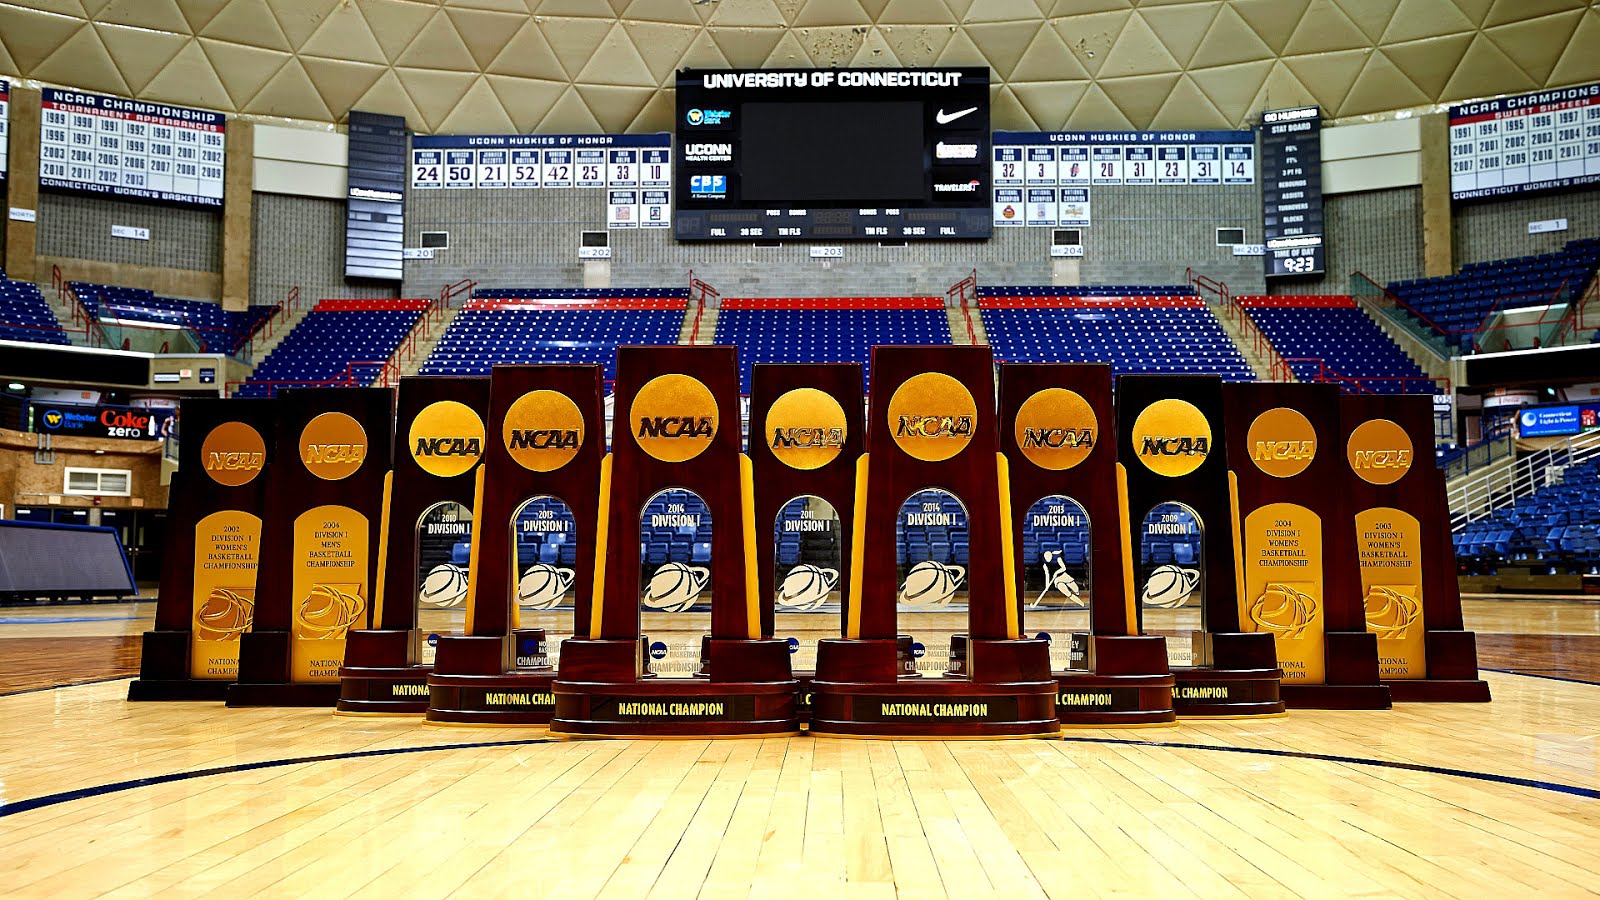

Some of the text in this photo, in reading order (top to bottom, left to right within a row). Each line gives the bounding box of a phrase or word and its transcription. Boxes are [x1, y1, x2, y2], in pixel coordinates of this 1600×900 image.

[704, 72, 962, 88] UNIVERSITY OF CONNECTICUT
[54, 91, 215, 122] NCAA CHAMPIONSHIP
[1460, 101, 1500, 116] NCAA
[1495, 99, 1590, 120] SWEET SIXTEEN
[52, 102, 217, 131] TOURNAMENT APPEARANCES
[46, 111, 221, 146] 1989 1990 1991 1992 1993 1994 1995
[1272, 122, 1311, 133] STAT BOARD
[1455, 111, 1578, 139] 1991 1994 1995 1996 1997
[45, 129, 221, 162] 1996 1997 1998 1999 2000 2001 2002
[510, 137, 554, 145] HUSKIES
[560, 137, 573, 145] OF
[1453, 128, 1580, 156] 2000 2001 2002 2003 2004
[686, 144, 732, 155] UCONN
[44, 146, 221, 178] 2003 2004 2005 2006 2007 2008 2009
[1454, 145, 1580, 172] 2007 2008 2009 2010 2011
[44, 164, 144, 186] 2010 2011 2012 2013
[417, 167, 438, 180] 24
[450, 167, 470, 180] 50
[485, 167, 501, 180] 21
[516, 167, 534, 180] 52
[548, 166, 568, 180] 42
[583, 166, 598, 180] 25
[617, 166, 629, 179] 33
[651, 166, 660, 179] 10
[1003, 163, 1014, 177] 32
[1039, 163, 1044, 177] 3
[1101, 163, 1113, 177] 20
[1134, 163, 1145, 177] 31
[1166, 163, 1178, 176] 23
[1198, 162, 1211, 176] 31
[1231, 162, 1245, 176] 14
[41, 178, 221, 206] CONNECTICUT WOMEN'S BASKETBALL
[1453, 179, 1569, 200] CONNECTICUT WOMEN'S
[134, 230, 146, 238] 14
[940, 227, 955, 235] FULL
[592, 249, 610, 257] 202
[1063, 247, 1082, 255] 204
[1274, 248, 1315, 258] TIME OF DAY
[1284, 257, 1314, 272] 9:23
[65, 412, 97, 422] Webster
[101, 410, 149, 429] Coke
[108, 427, 141, 438] zero
[638, 416, 714, 438] NCAA
[897, 415, 972, 438] NCAA
[510, 430, 580, 449] NCAA
[772, 427, 844, 448] NCAA
[1023, 428, 1094, 448] NCAA
[415, 438, 480, 457] NCAA
[1140, 436, 1208, 457] NCAA
[1255, 441, 1314, 460] NCAA
[208, 453, 262, 470] NCAA
[306, 445, 364, 464] NCAA
[1355, 451, 1411, 468] NCAA
[667, 504, 684, 514] 2014
[923, 502, 940, 512] 2014
[1049, 505, 1064, 514] 2013
[442, 514, 456, 522] 2010
[539, 510, 553, 519] 2013
[652, 514, 694, 527] DIVISION
[908, 513, 950, 526] DIVISION
[1034, 515, 1074, 527] DIVISION
[428, 524, 465, 534] DIVISION
[524, 520, 563, 532] DIVISION
[785, 520, 822, 532] DIVISION
[1149, 524, 1186, 534] DIVISION
[648, 662, 704, 672] CHAMPIONSHIP
[904, 662, 961, 670] CHAMPIONSHIP
[486, 693, 531, 705] NATIONAL
[1062, 694, 1111, 705] CHAMPION
[1182, 687, 1228, 698] CHAMPION
[619, 703, 723, 715] NATIONAL CHAMPION
[882, 703, 988, 717] NATIONAL CHAMPION
